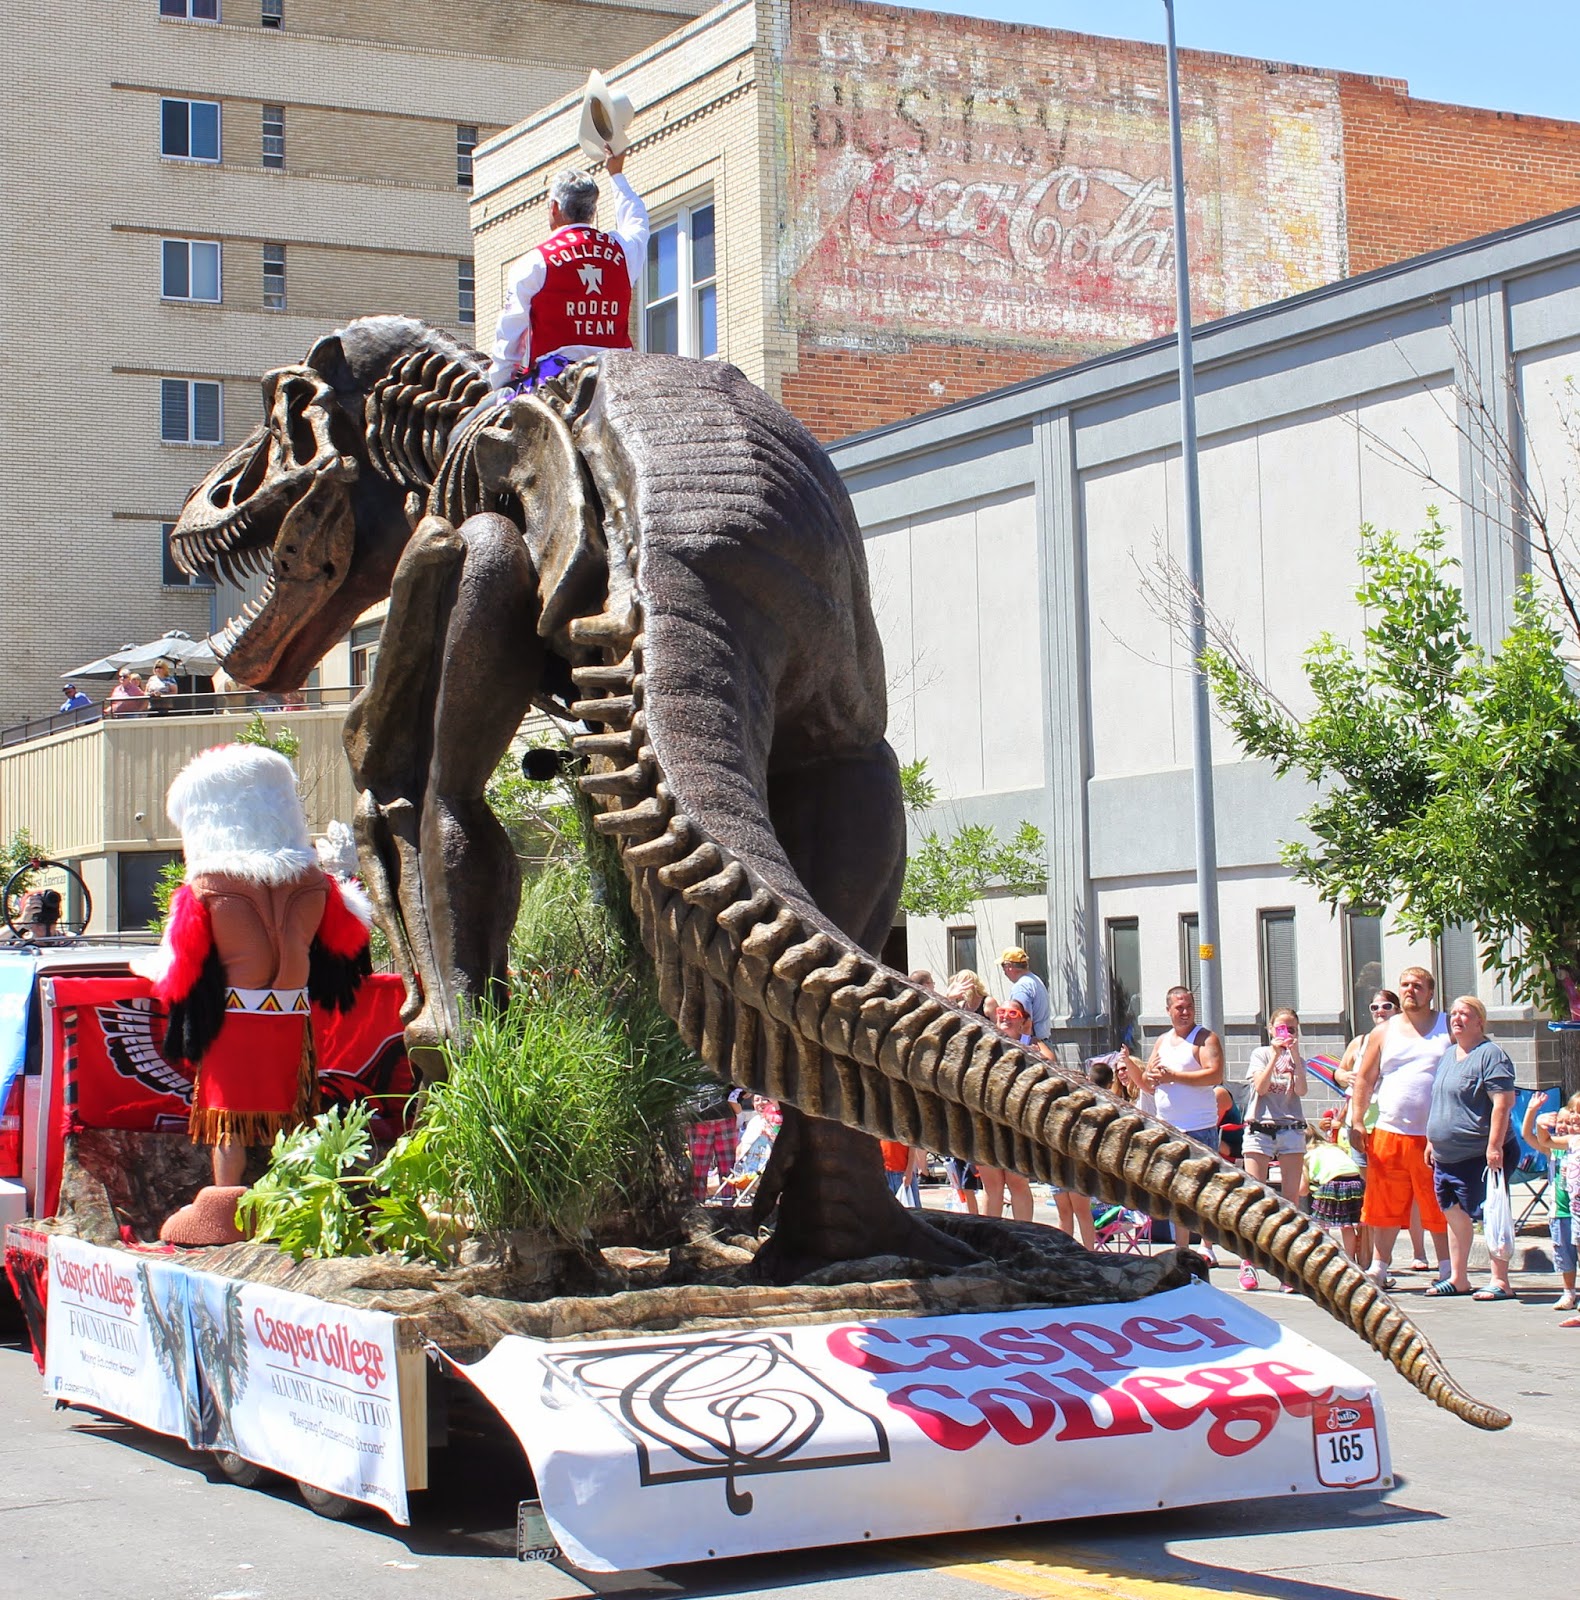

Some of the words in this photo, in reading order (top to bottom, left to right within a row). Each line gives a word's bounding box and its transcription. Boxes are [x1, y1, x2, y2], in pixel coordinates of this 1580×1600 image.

[544, 230, 616, 251] CASPER
[548, 244, 624, 267] COLLEGE
[566, 301, 619, 317] RODEO
[574, 320, 615, 335] TEAM
[56, 1252, 94, 1302] Casper
[93, 1263, 136, 1317] College
[69, 1310, 139, 1356] FOUNDATION
[254, 1307, 319, 1369] Casper
[316, 1322, 386, 1389] College
[826, 1313, 1251, 1374] Casper
[271, 1373, 315, 1406] ALUMNI
[315, 1386, 393, 1430] ASSOCIATION
[887, 1361, 1333, 1457] College
[1329, 1433, 1364, 1464] 165
